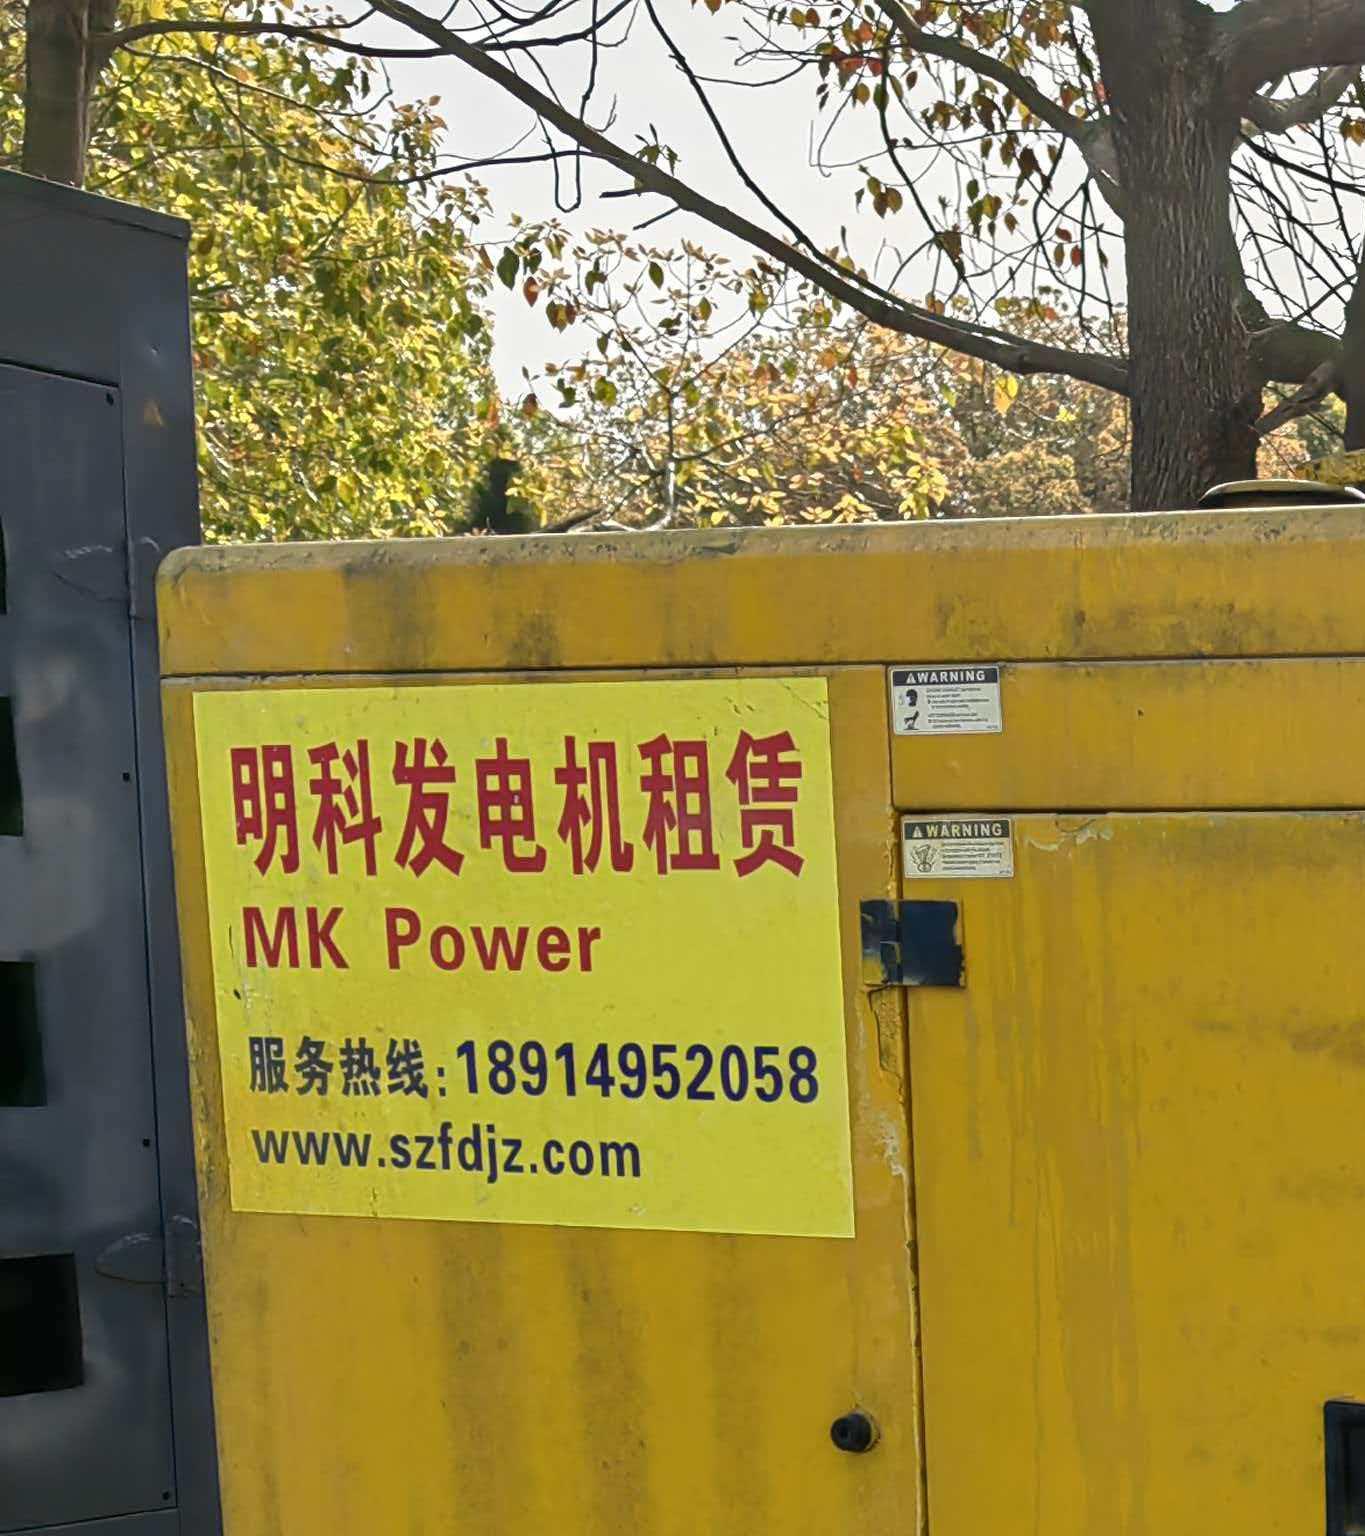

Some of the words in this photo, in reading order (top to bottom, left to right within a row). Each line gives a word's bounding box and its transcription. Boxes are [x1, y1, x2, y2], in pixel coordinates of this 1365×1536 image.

[917, 670, 986, 683] WARNING
[230, 730, 804, 878] 明科发电机租赁
[926, 822, 1002, 837] WARNING
[242, 906, 350, 969] MK
[384, 907, 601, 972] Power
[251, 1121, 642, 1184] www.szfdjz.com
